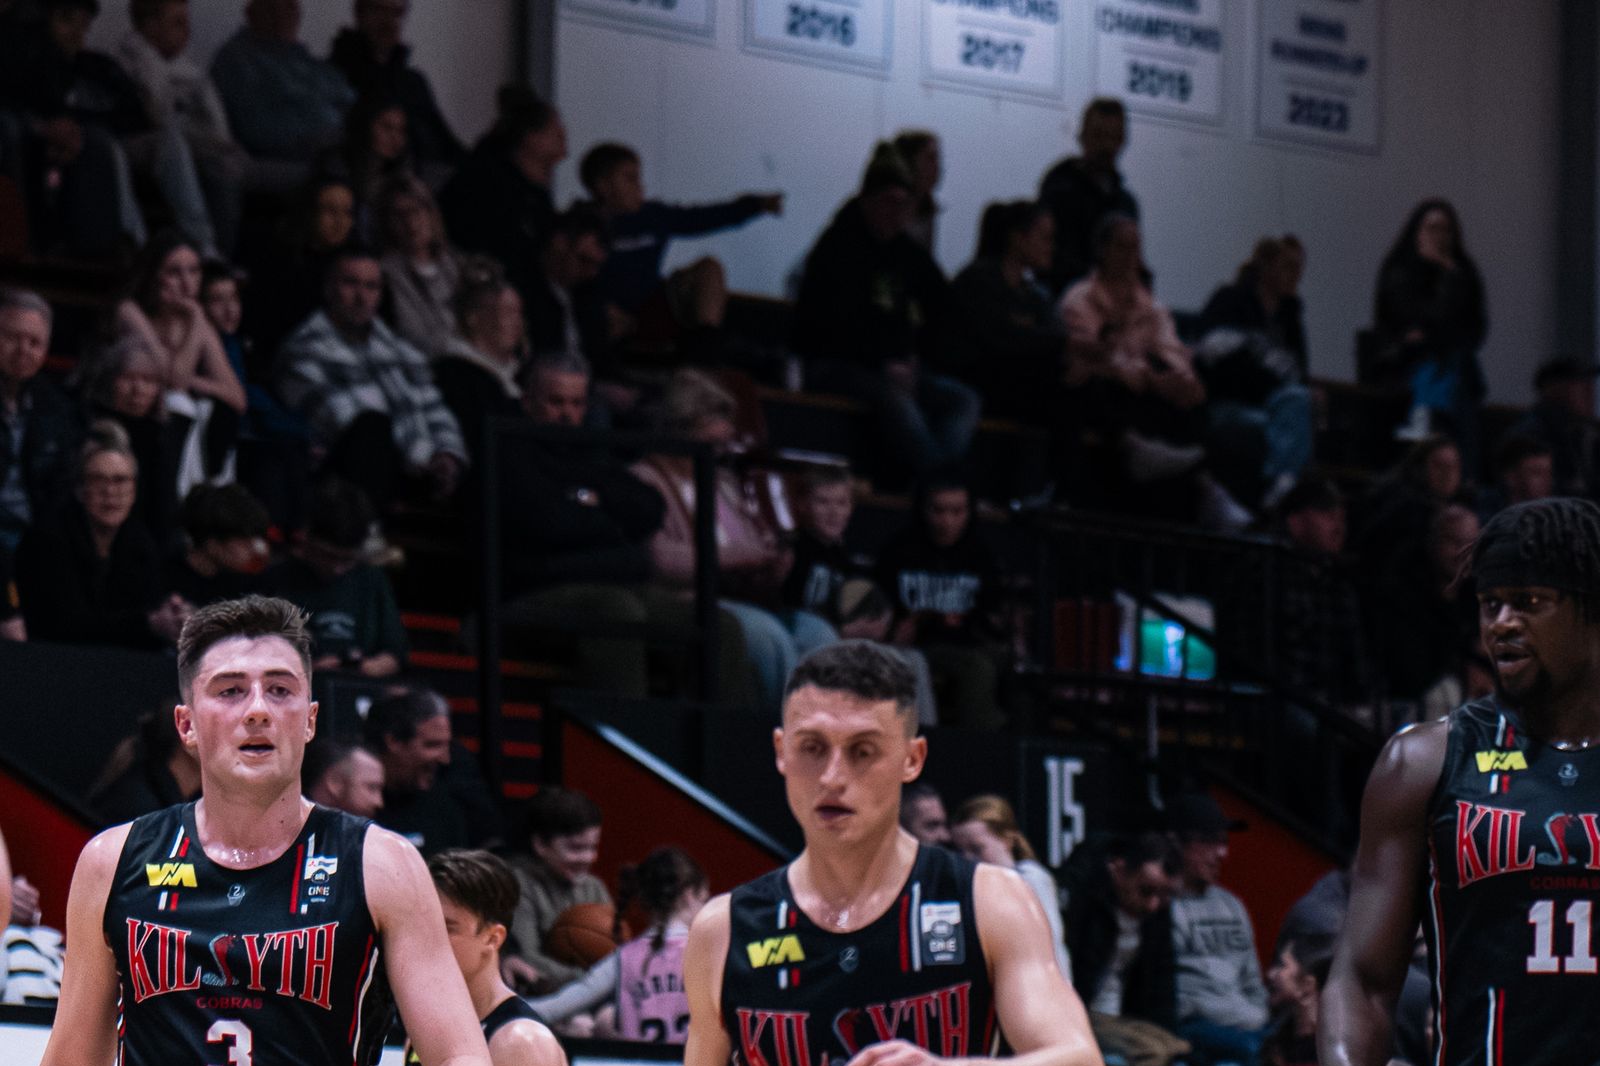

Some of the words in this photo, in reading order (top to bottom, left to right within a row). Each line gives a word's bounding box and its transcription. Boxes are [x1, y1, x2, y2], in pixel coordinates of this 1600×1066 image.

[1044, 756, 1086, 868] 15
[126, 918, 339, 1010] KILSYTH
[1527, 900, 1598, 974] 11
